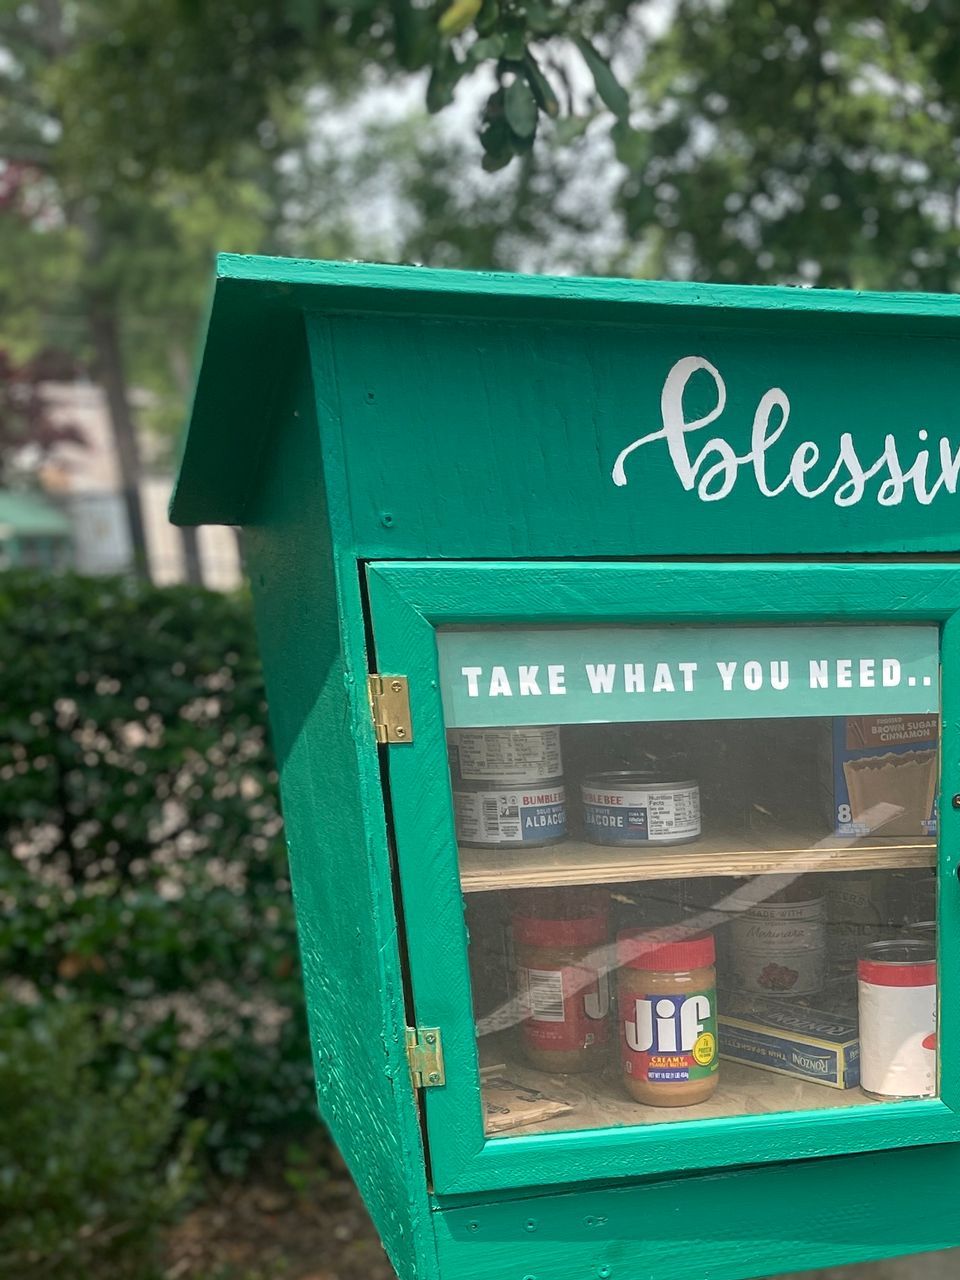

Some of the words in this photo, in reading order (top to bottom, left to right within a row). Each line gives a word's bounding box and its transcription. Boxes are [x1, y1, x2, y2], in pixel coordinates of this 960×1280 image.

[461, 665, 567, 697] TAKE
[585, 662, 698, 694] WHAT
[716, 660, 789, 691] YOU
[871, 724, 905, 734] BROWN
[907, 720, 937, 730] SUGAR
[880, 729, 930, 741] CINNAMON
[837, 804, 851, 823] 8
[624, 995, 711, 1052] Jif
[767, 1050, 787, 1061] THIN
[792, 1052, 828, 1073] RONZONI
